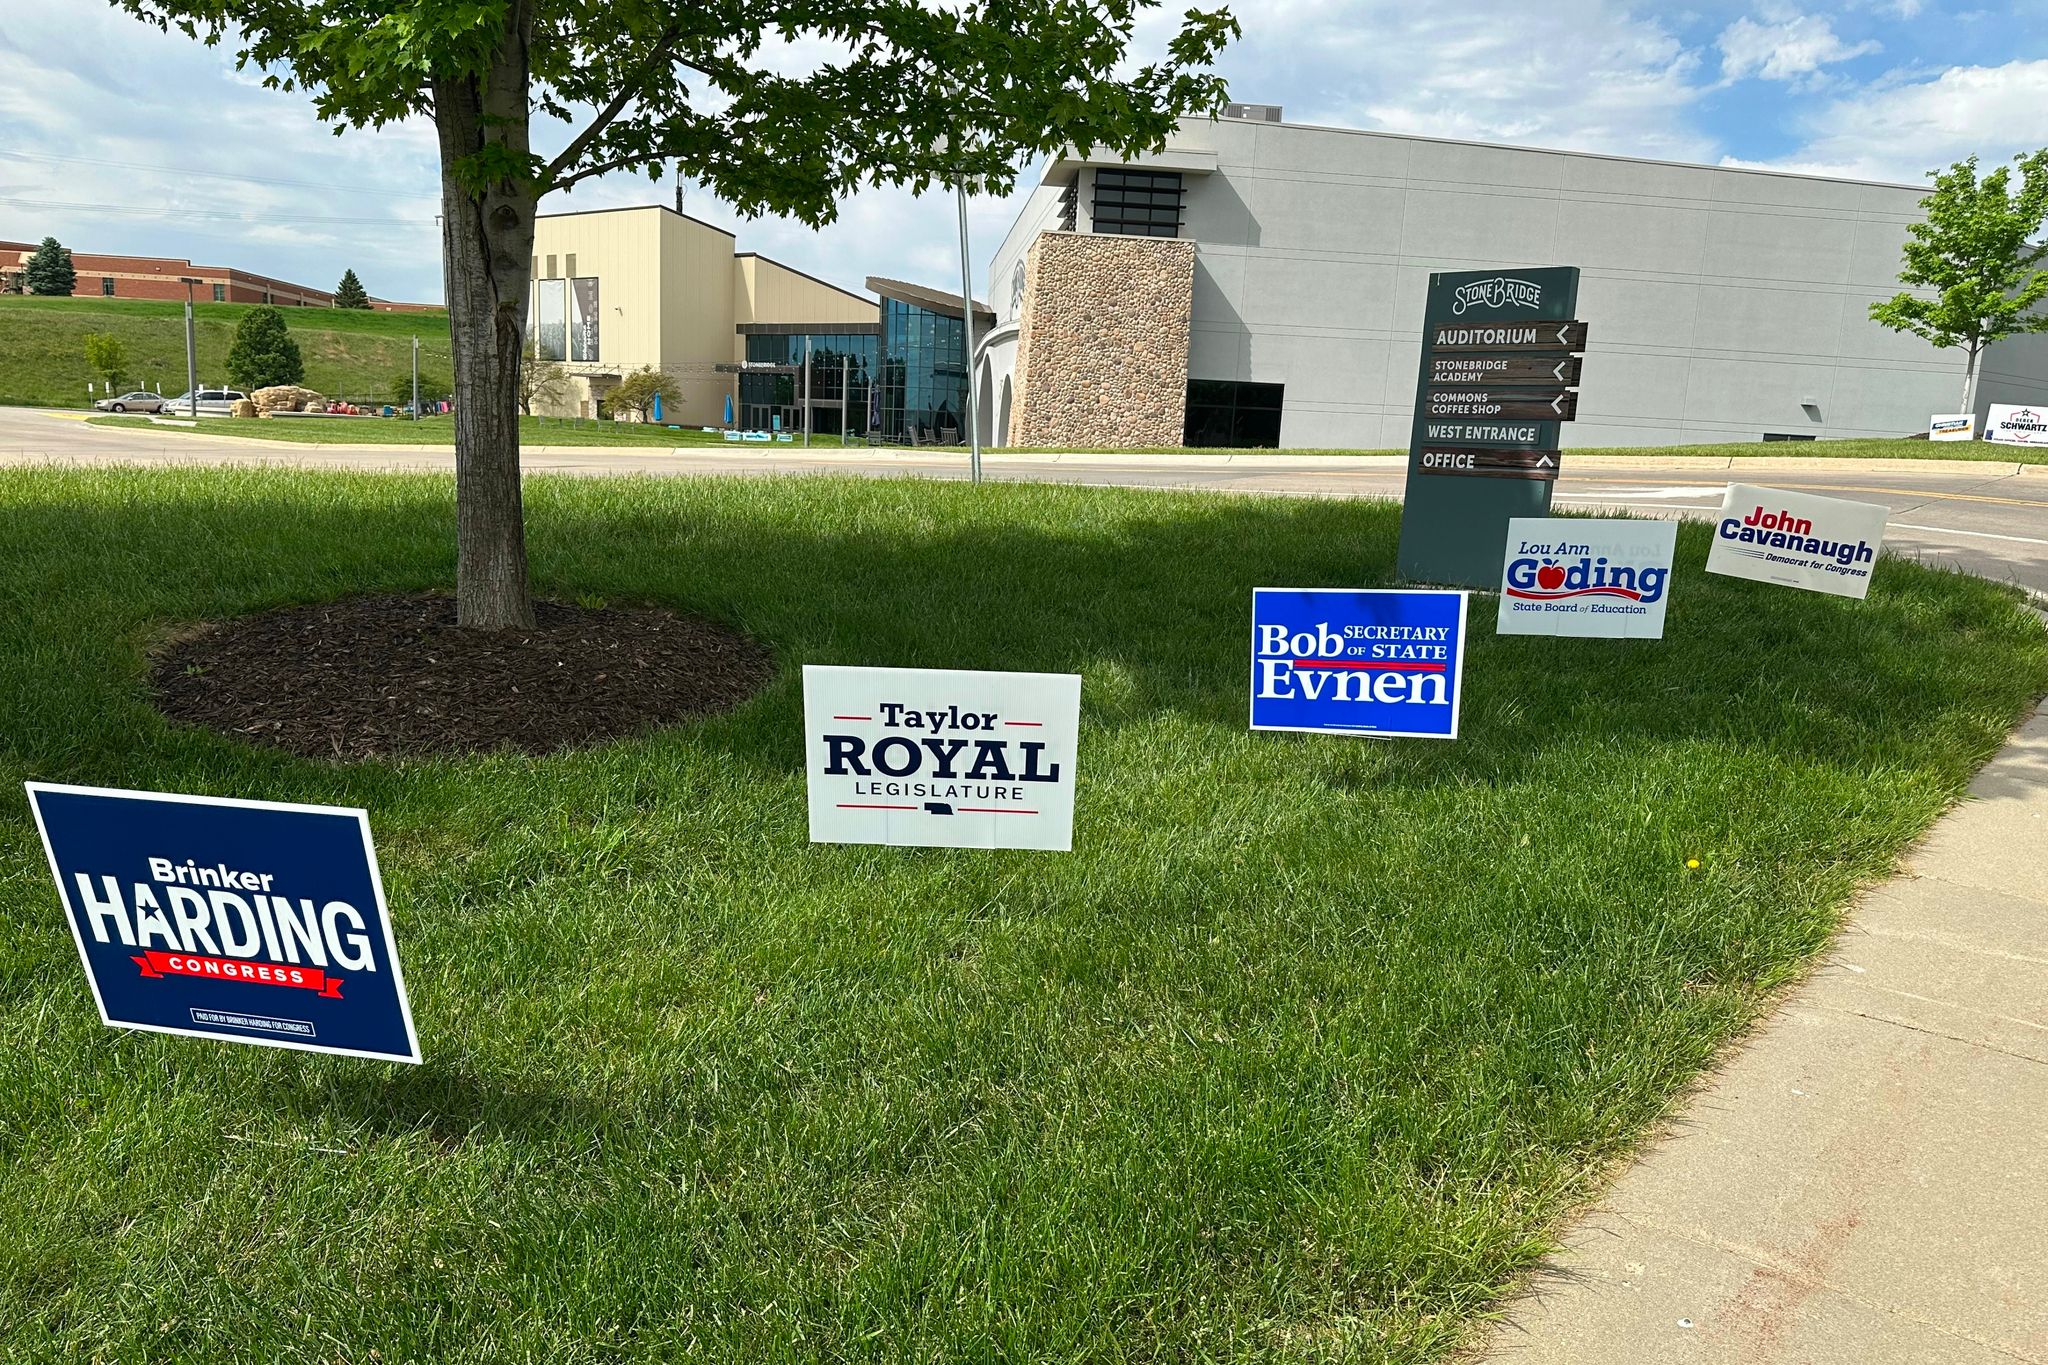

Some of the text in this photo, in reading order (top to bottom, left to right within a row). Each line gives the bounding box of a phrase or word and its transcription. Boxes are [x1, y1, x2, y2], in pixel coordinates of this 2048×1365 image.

[1437, 328, 1536, 345] AUDITORIUM
[1435, 360, 1508, 370] STONEBRIDGE
[1433, 372, 1483, 382] ACADEMY
[1433, 393, 1488, 402] COMMONS
[1432, 404, 1501, 414] COFFEE SHOP
[1428, 425, 1535, 441] WEST ENTRANCE
[2000, 422, 2048, 432] SCHWARTZ
[1423, 453, 1475, 469] OFFICE
[1744, 505, 1812, 536] John
[1518, 542, 1550, 555] Lou
[1553, 542, 1590, 555] Ann
[1719, 518, 1873, 565] Cavanaugh
[1765, 553, 1868, 577] Democrat for Congress
[1513, 602, 1647, 615] State Board of Education
[1257, 622, 1449, 657] Bob SECRETARY
[1347, 644, 1448, 660] OF STATE
[1256, 658, 1449, 705] Evnen
[880, 702, 998, 734] Taylor
[823, 734, 1060, 783] ROYAL
[855, 781, 1024, 800] LEGISLATURE
[148, 857, 273, 892] Brinker
[74, 872, 376, 972] HARDING
[168, 957, 304, 984] CONGRESS
[195, 1012, 209, 1021] PAID
[209, 1014, 218, 1022] FOR
[272, 1021, 283, 1030] FOR
[282, 1022, 311, 1033] CONGRESS
